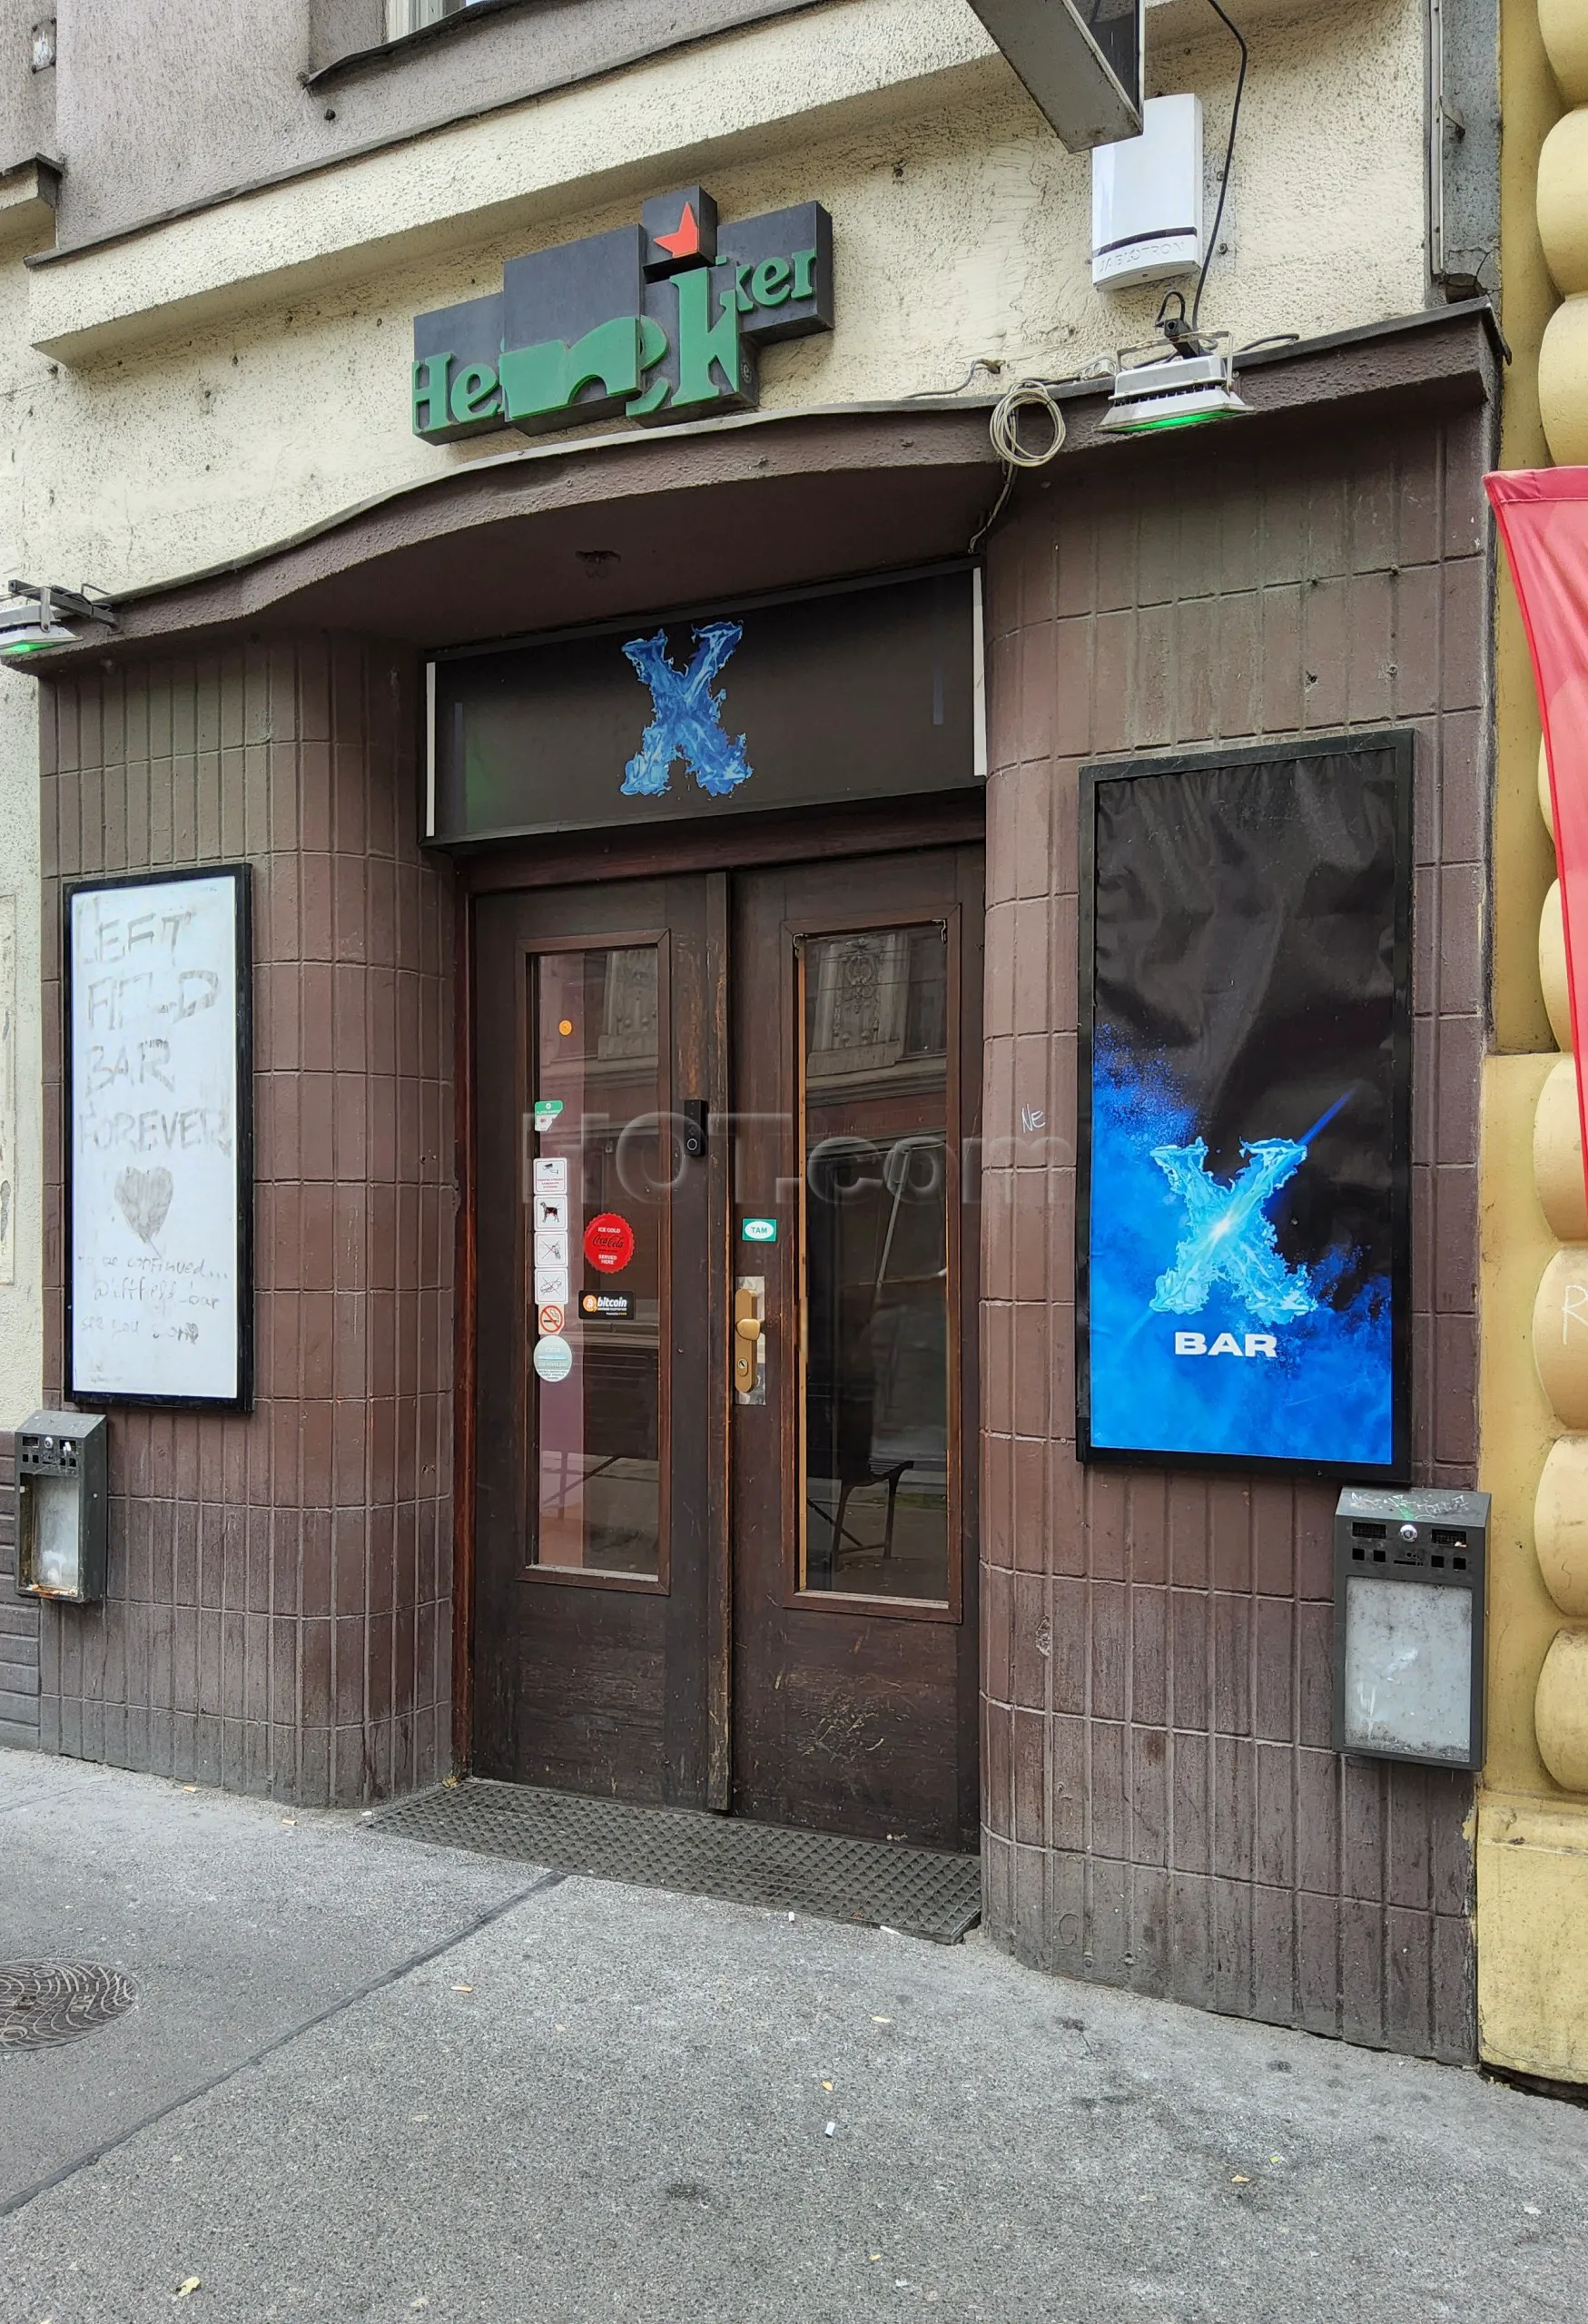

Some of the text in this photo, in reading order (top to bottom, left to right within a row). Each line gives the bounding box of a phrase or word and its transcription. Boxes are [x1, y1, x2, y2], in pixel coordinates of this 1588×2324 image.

[1099, 241, 1184, 273] JABLOTRON
[411, 247, 817, 436] Heneke
[620, 621, 755, 797] X
[86, 1040, 175, 1098] BAR
[751, 1226, 768, 1235] TAM
[1149, 1137, 1317, 1325] X
[597, 1296, 627, 1307] bitcoin
[1174, 1331, 1277, 1358] BAR
